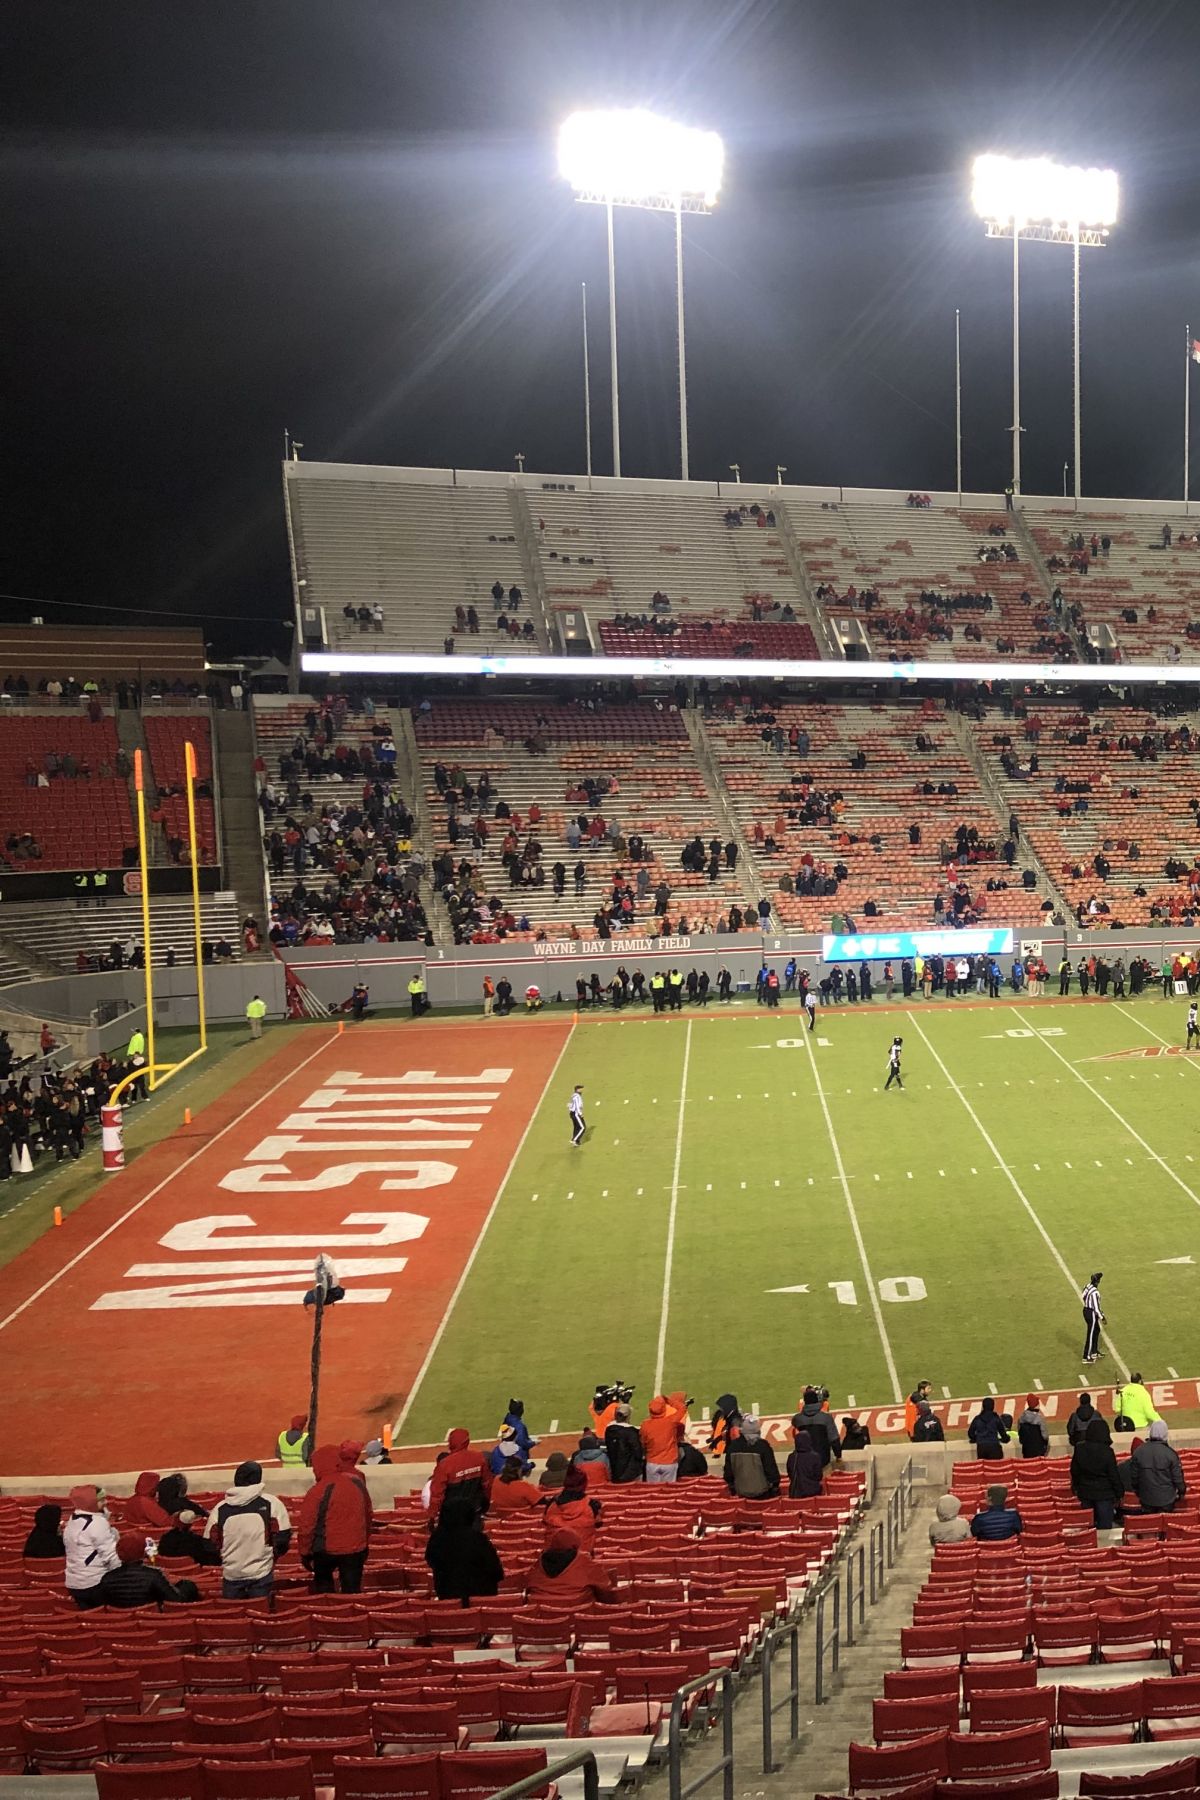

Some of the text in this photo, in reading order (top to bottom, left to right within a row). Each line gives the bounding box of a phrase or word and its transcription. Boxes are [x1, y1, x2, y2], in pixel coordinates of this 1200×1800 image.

[533, 937, 691, 955] WAYNE DAY FAMILY FIELD
[774, 940, 781, 949] 2
[88, 1068, 514, 1310] NC STATE
[828, 1276, 928, 1305] 10
[1084, 1385, 1178, 1415] TE
